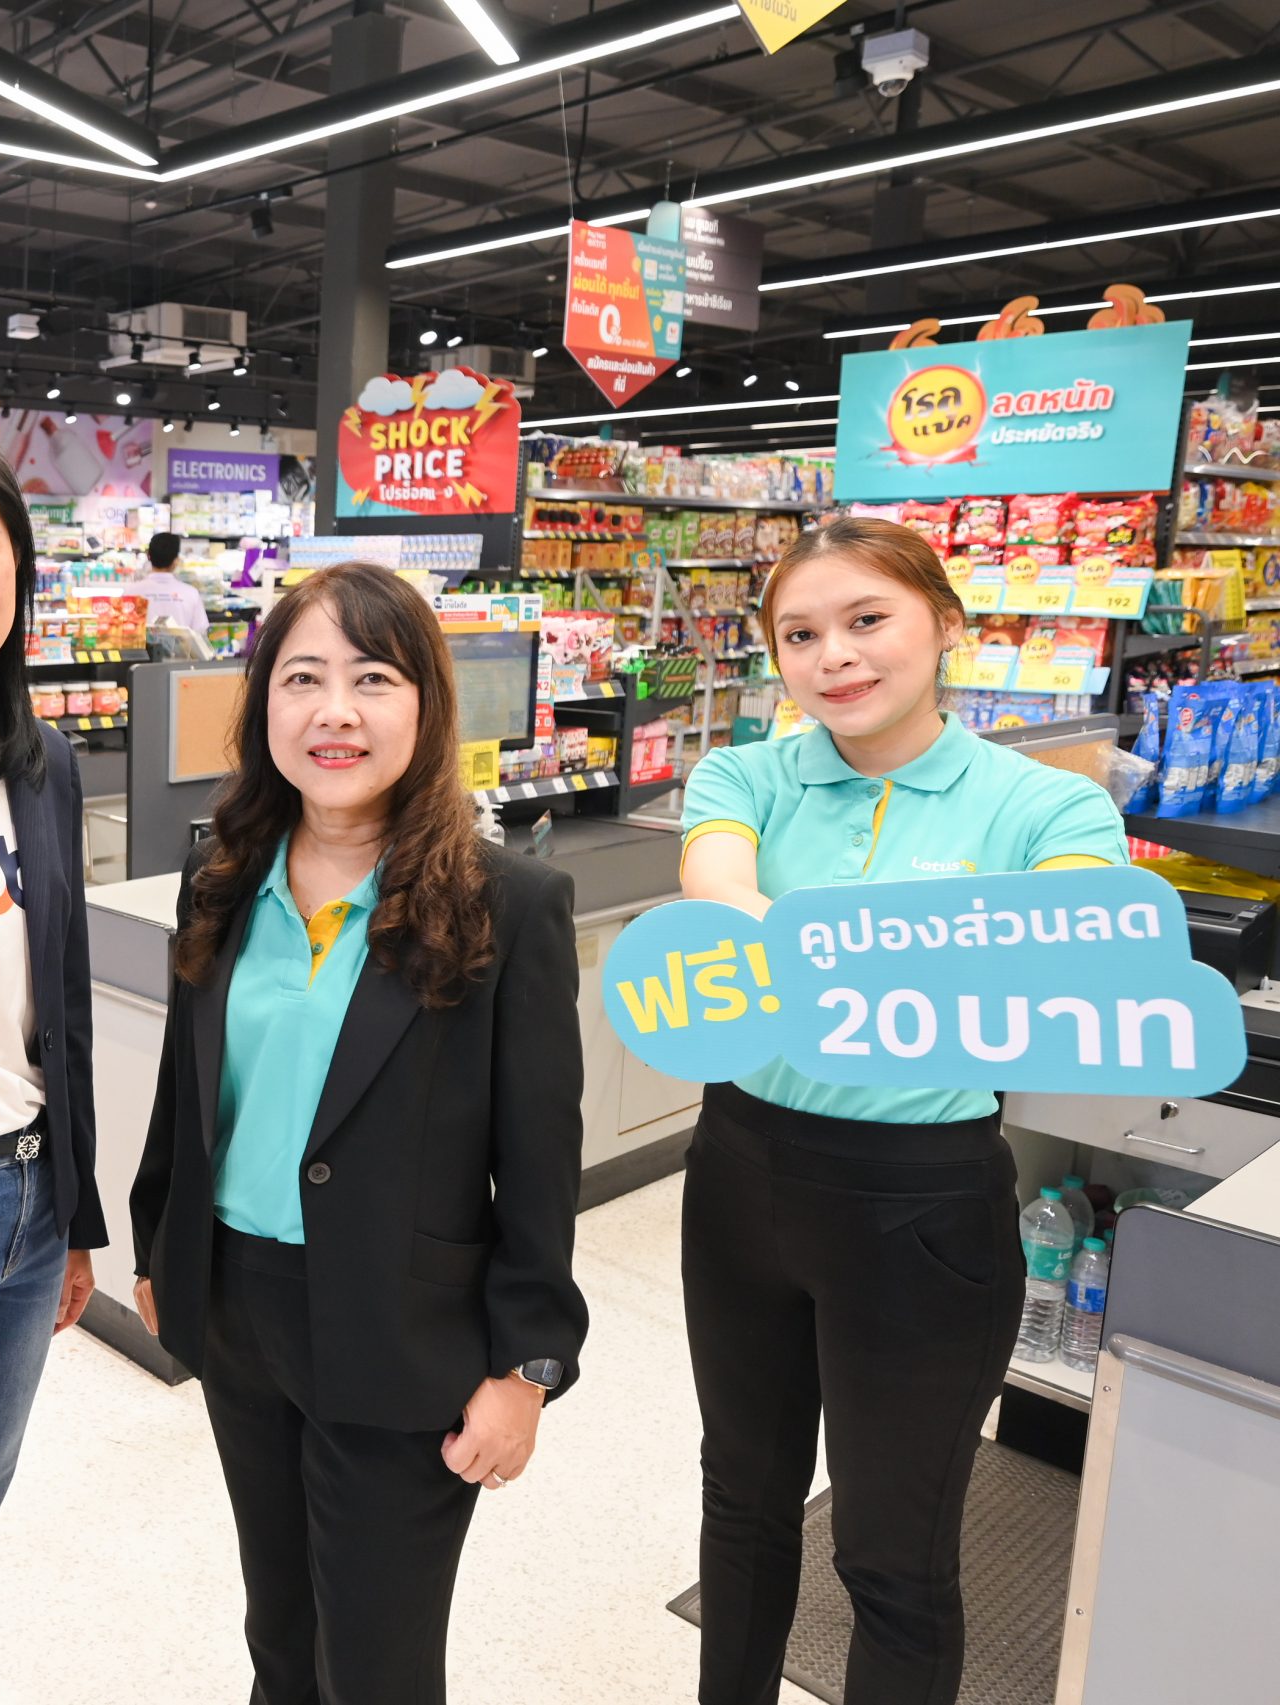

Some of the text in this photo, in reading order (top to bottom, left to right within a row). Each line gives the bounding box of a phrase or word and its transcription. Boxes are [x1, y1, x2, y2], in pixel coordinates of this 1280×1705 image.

[991, 379, 1115, 417] ลดหนัก
[370, 415, 471, 450] SHOCK
[991, 421, 1105, 445] ประหยัดจริง
[172, 460, 267, 482] ELECTRONICS
[374, 448, 466, 482] PRICE
[379, 479, 455, 502] โปรช็อคแง
[971, 594, 993, 604] 192
[1037, 595, 1060, 605] 192
[1107, 597, 1131, 607] 192
[1053, 676, 1071, 685] 50
[911, 856, 977, 873] Lotus's
[800, 898, 1160, 970] คูปองส่วนลด
[617, 940, 781, 1033] ฟรี!
[818, 988, 1196, 1070] 20 บาท
